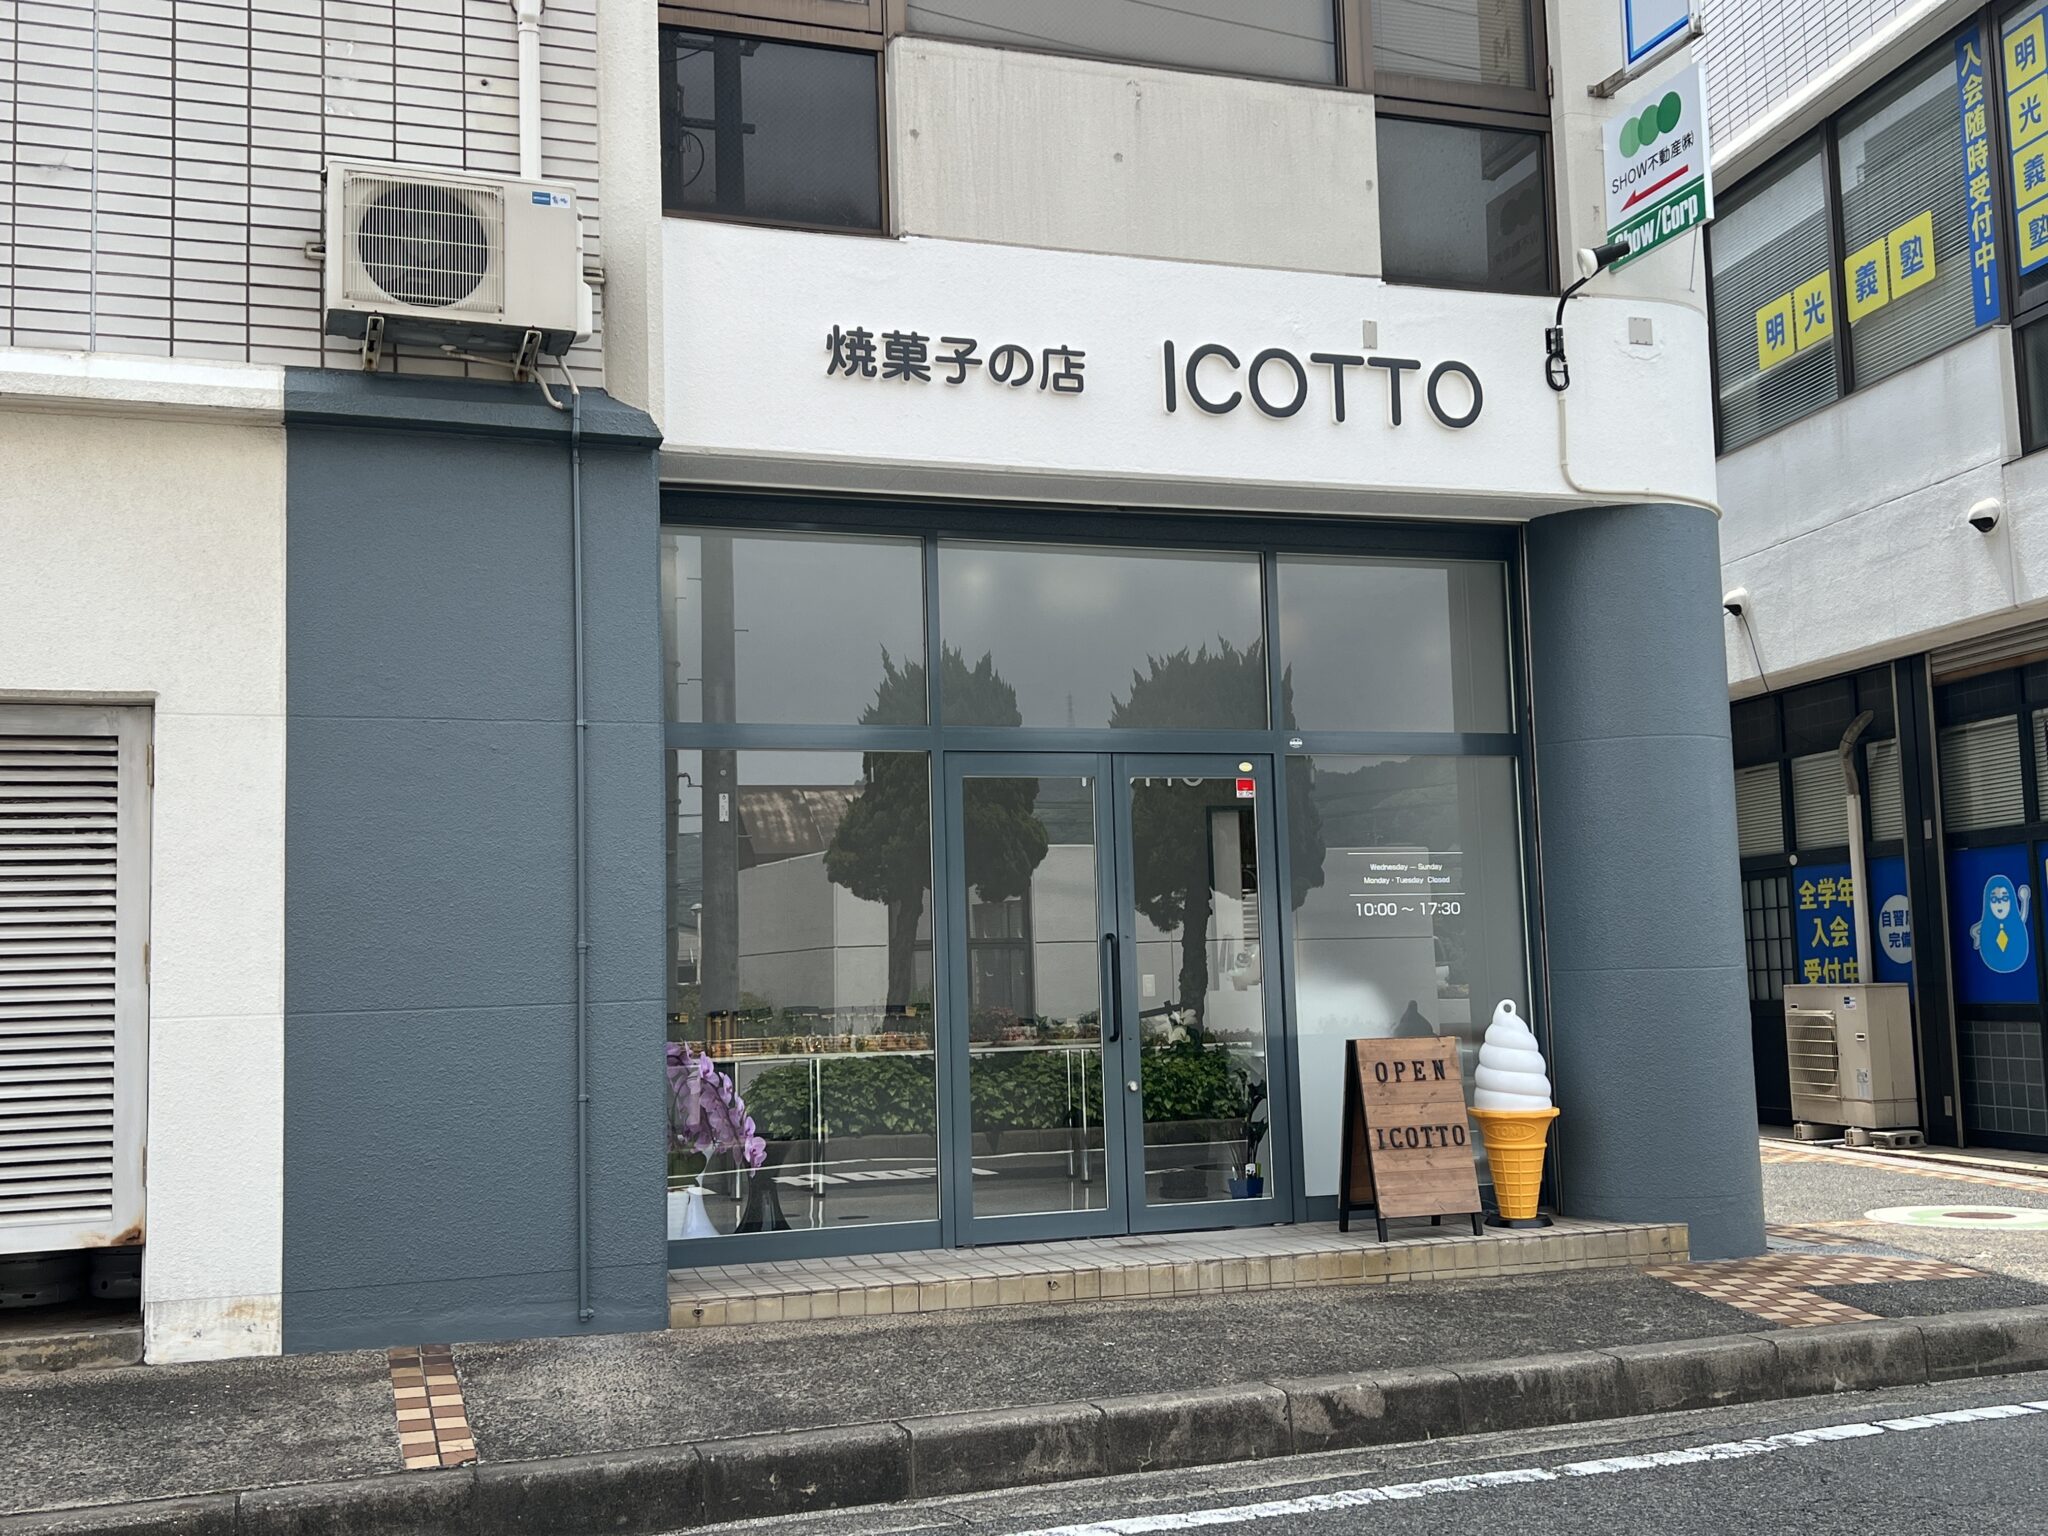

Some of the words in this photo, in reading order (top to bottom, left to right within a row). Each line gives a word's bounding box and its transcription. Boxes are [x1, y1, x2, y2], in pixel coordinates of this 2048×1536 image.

[2014, 33, 2048, 251] 明光義塾
[1961, 41, 1995, 305] 入会随時受付中!
[827, 325, 1085, 392] 焼菓子の店
[1165, 341, 1482, 428] ICOTTO
[1363, 876, 1390, 885] Monday
[1395, 876, 1424, 884] Tuesday
[1370, 863, 1408, 871] Wednesday
[1417, 862, 1443, 871] Sunday
[1798, 876, 1854, 909] 全学年
[1356, 902, 1397, 916] 10:00
[1419, 902, 1461, 915] 17:30
[1811, 915, 1849, 948] 入会
[1804, 956, 1860, 984] 受付中
[1375, 1060, 1445, 1083] OPEN
[1376, 1124, 1466, 1150] ICOTTO
